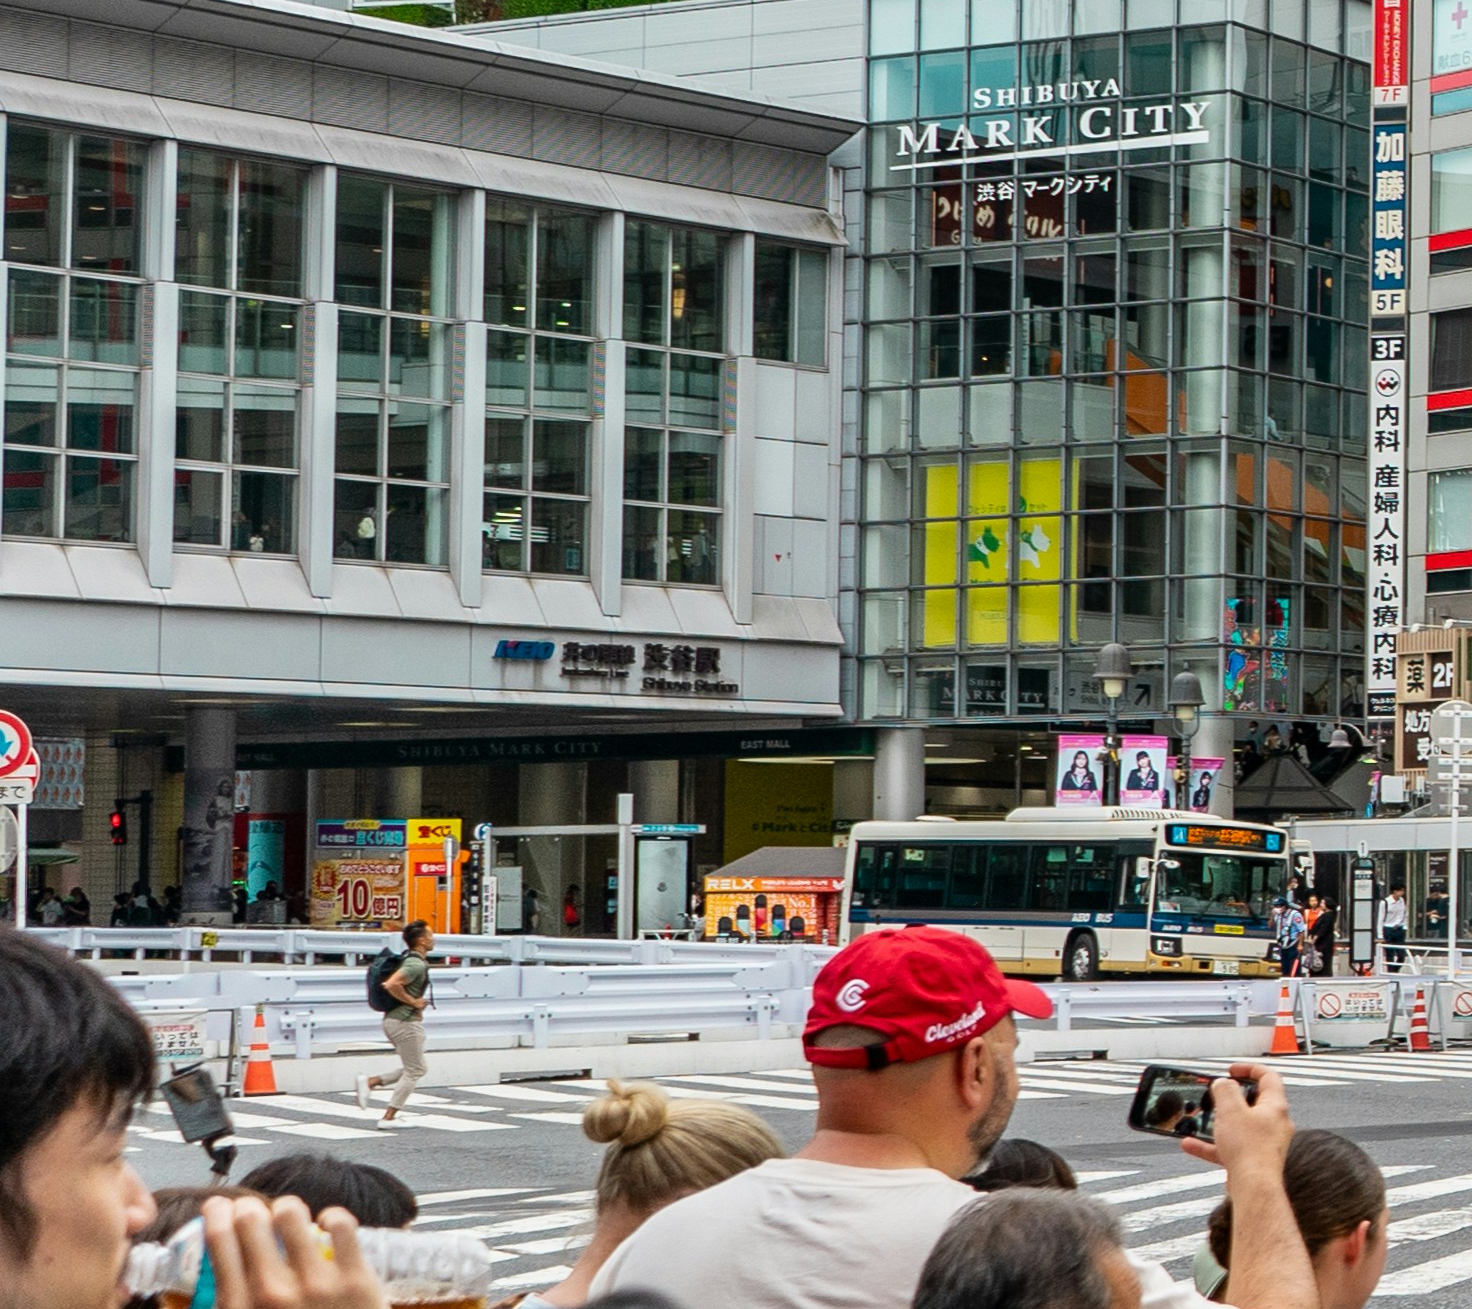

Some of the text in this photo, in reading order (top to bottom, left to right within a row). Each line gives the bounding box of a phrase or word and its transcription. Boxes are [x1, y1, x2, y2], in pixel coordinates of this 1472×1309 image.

[974, 78, 1121, 110] SHIBUYA
[1381, 88, 1401, 102] 7F
[896, 100, 1212, 157] MARK CITY
[977, 174, 1112, 203] 渋谷 マークシティ
[1374, 130, 1405, 283] 加藤眼科
[1377, 293, 1402, 312] 5F
[1375, 338, 1402, 360] 3F
[1372, 404, 1401, 681] 内科 産婦人科・心療内科
[1406, 659, 1425, 694] 薬
[553, 741, 602, 755] CITY
[741, 740, 792, 750] EAST MALL
[338, 878, 401, 919] 10 億円
[706, 878, 756, 890] RELX
[1095, 913, 1114, 923] BUS
[924, 1000, 987, 1044] Cleveland
